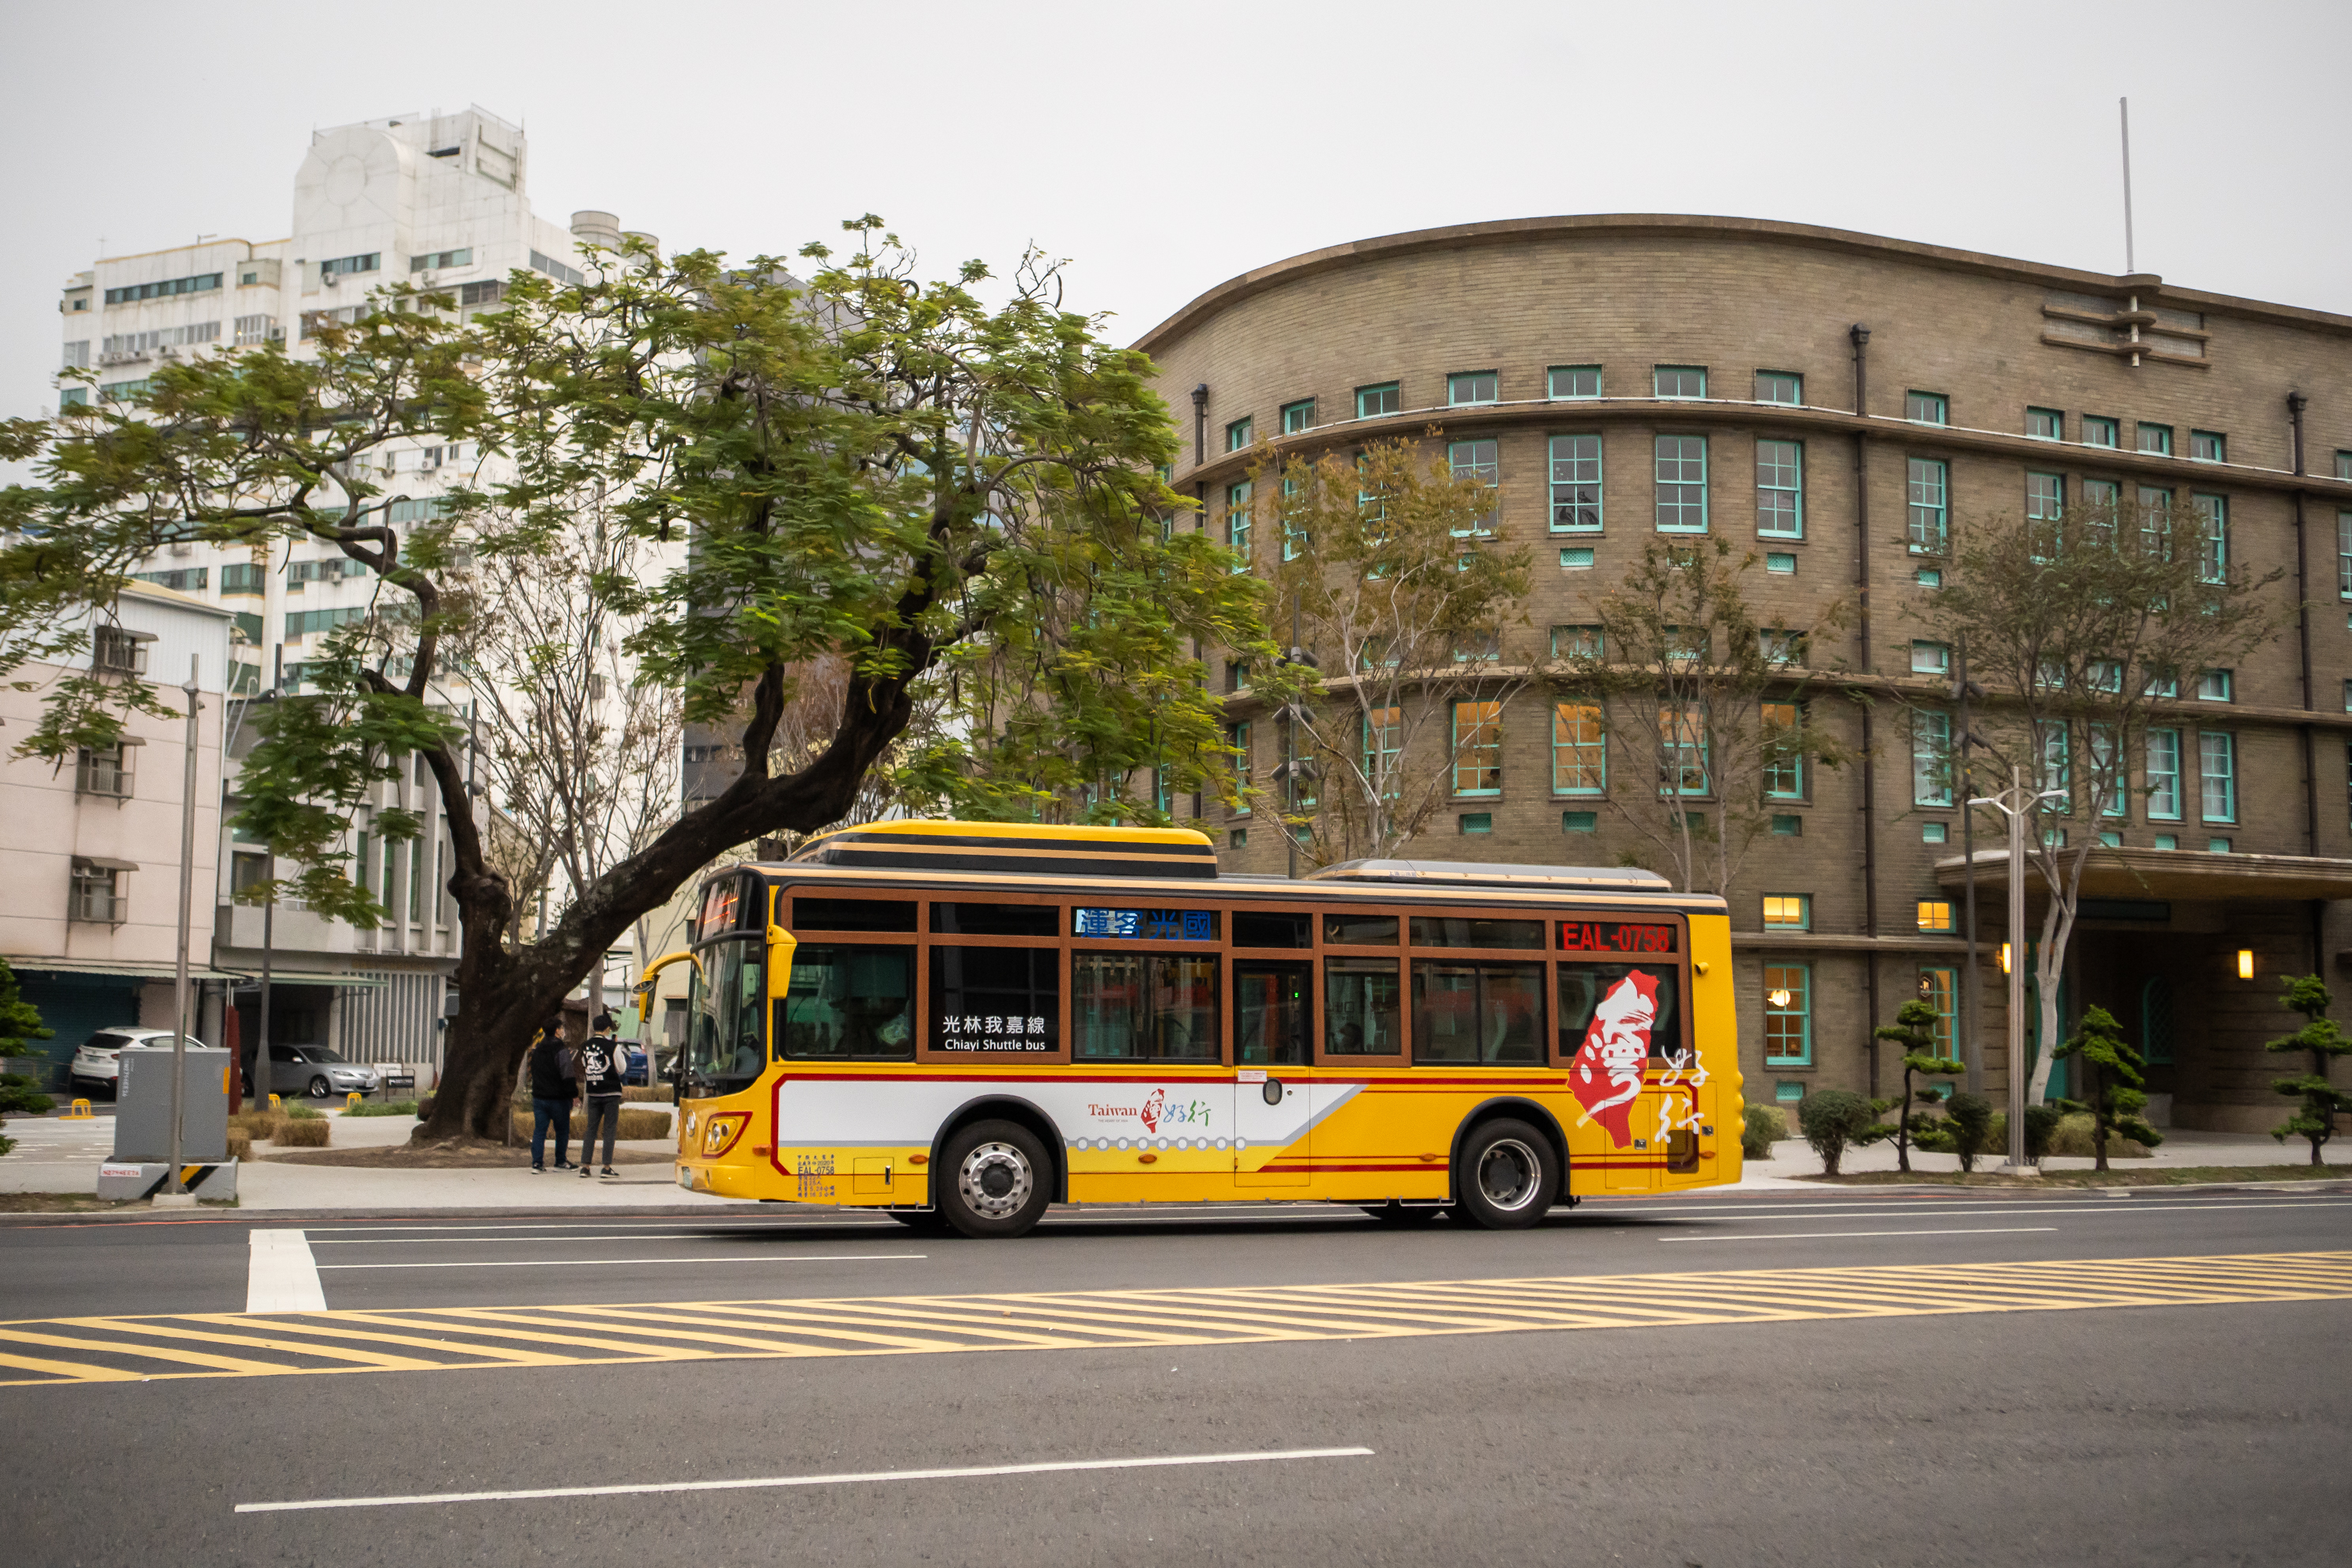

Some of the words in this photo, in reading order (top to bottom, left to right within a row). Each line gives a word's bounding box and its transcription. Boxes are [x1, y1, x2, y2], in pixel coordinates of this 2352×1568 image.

[1563, 923, 1669, 952] EAL-0758
[943, 1015, 1045, 1033] 光林我嘉線
[945, 1039, 979, 1052] Chiayi
[983, 1039, 1022, 1050] Shuttle
[1026, 1040, 1046, 1050] bus
[1087, 1104, 1137, 1116] Taiwan
[798, 1166, 835, 1175] EAL-0758
